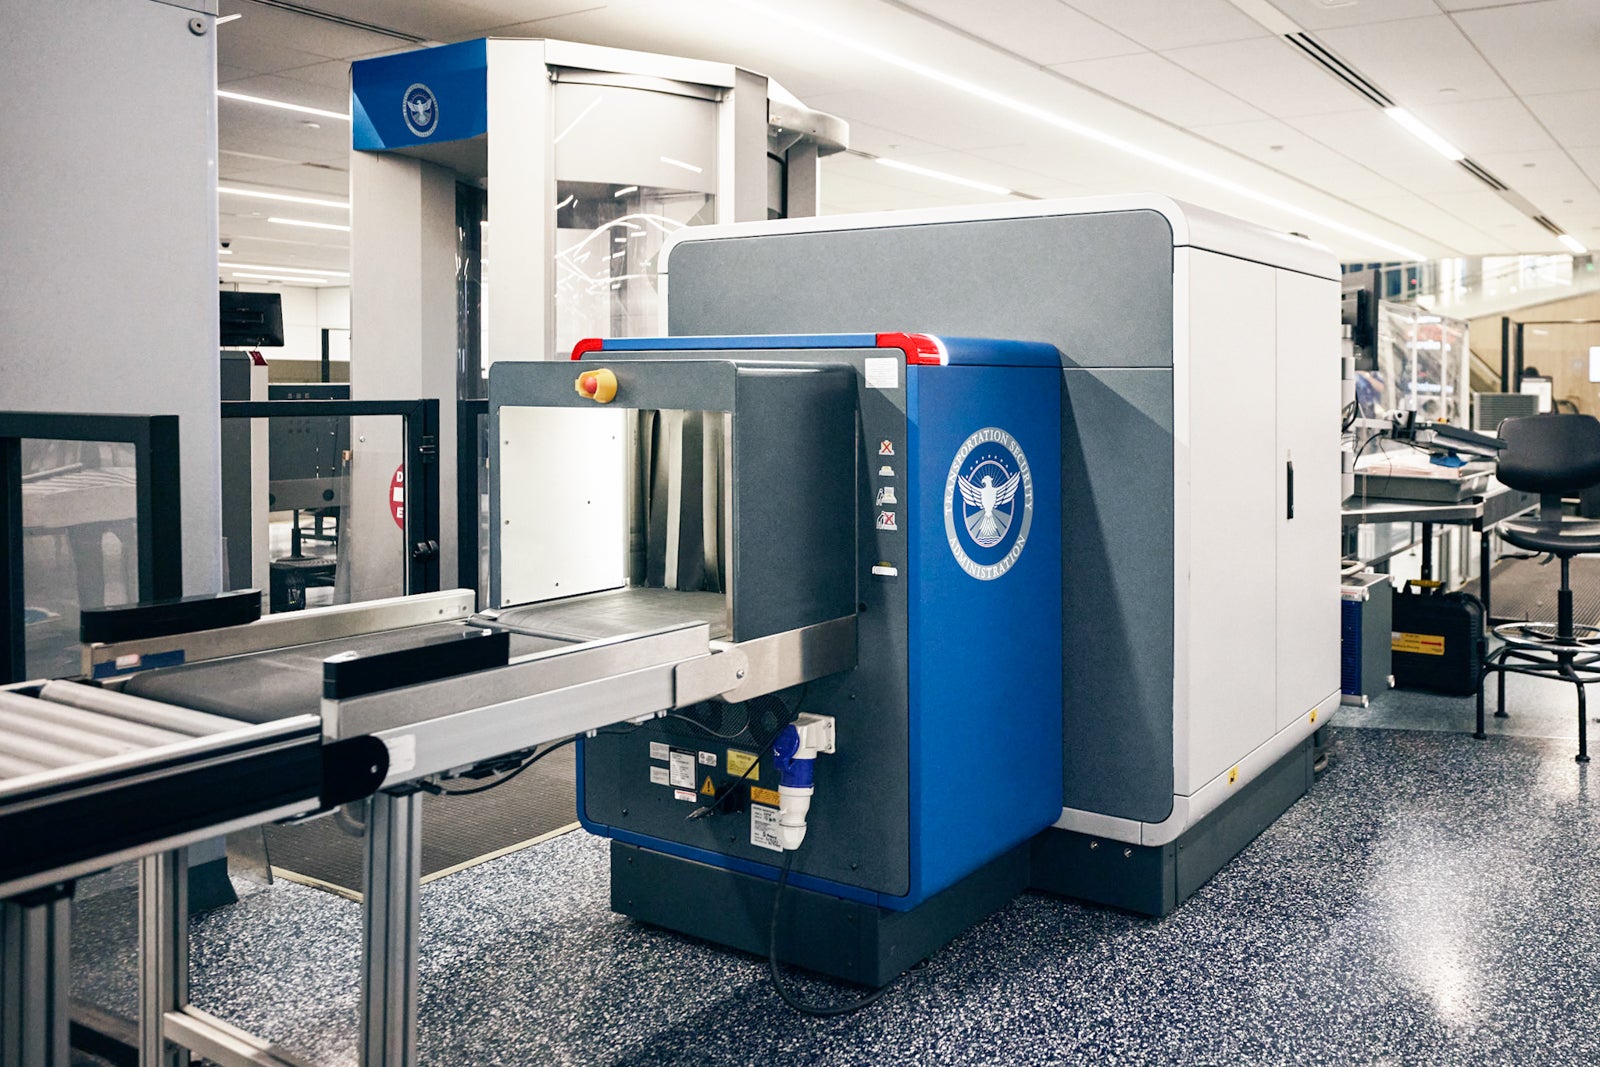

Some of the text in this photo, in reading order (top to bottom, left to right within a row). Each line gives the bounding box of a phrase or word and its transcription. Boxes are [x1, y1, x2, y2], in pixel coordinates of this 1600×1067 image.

[396, 471, 403, 482] D
[945, 429, 1033, 513] TRANSPORTATION SECURITY
[950, 536, 1025, 578] ADMINISTRATION
